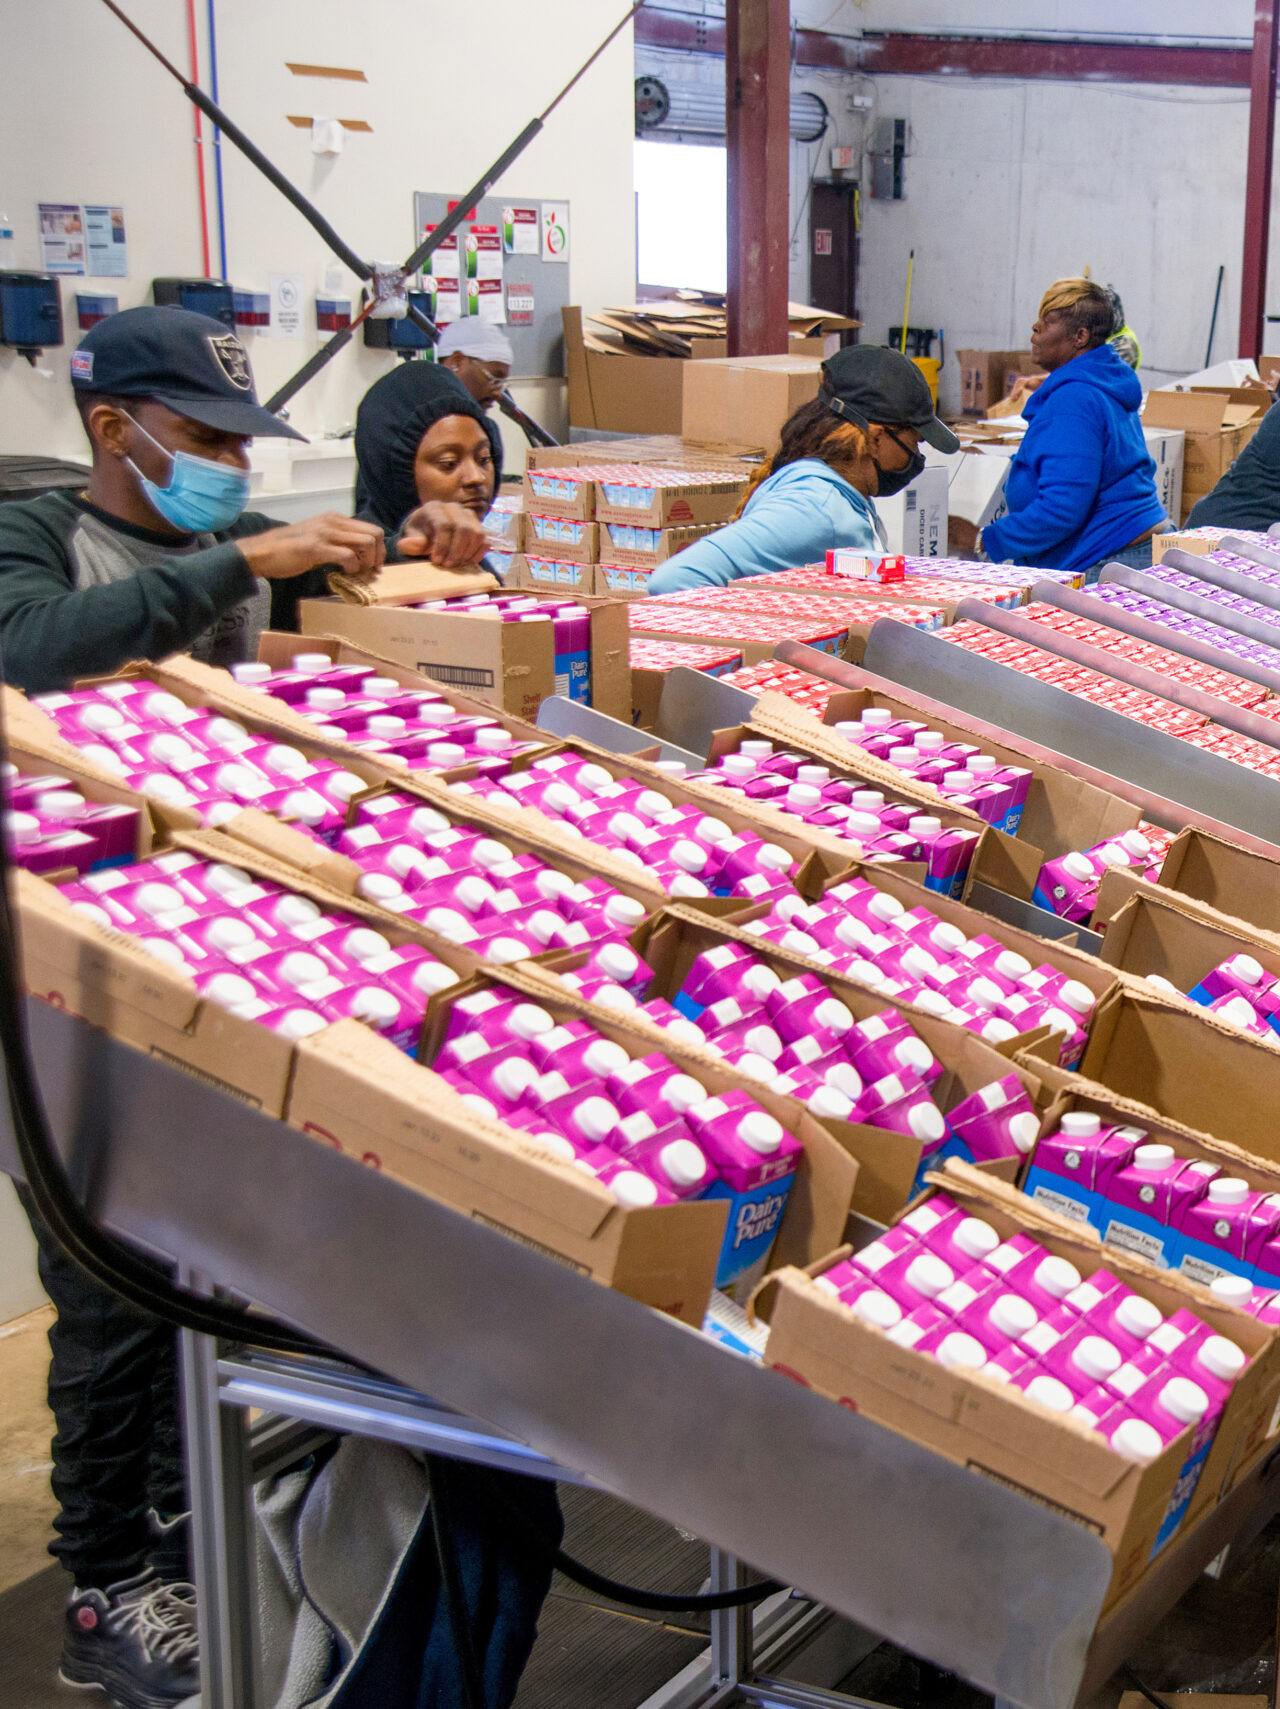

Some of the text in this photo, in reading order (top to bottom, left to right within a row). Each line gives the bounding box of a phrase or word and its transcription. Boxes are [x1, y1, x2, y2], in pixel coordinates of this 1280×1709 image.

[570, 660, 588, 673] Dairy
[571, 669, 587, 680] Pure
[736, 1193, 788, 1228] Dairy
[1036, 1188, 1066, 1209] Nutrition
[733, 1212, 778, 1250] Pure
[1110, 1223, 1160, 1251] Nutrition Facts
